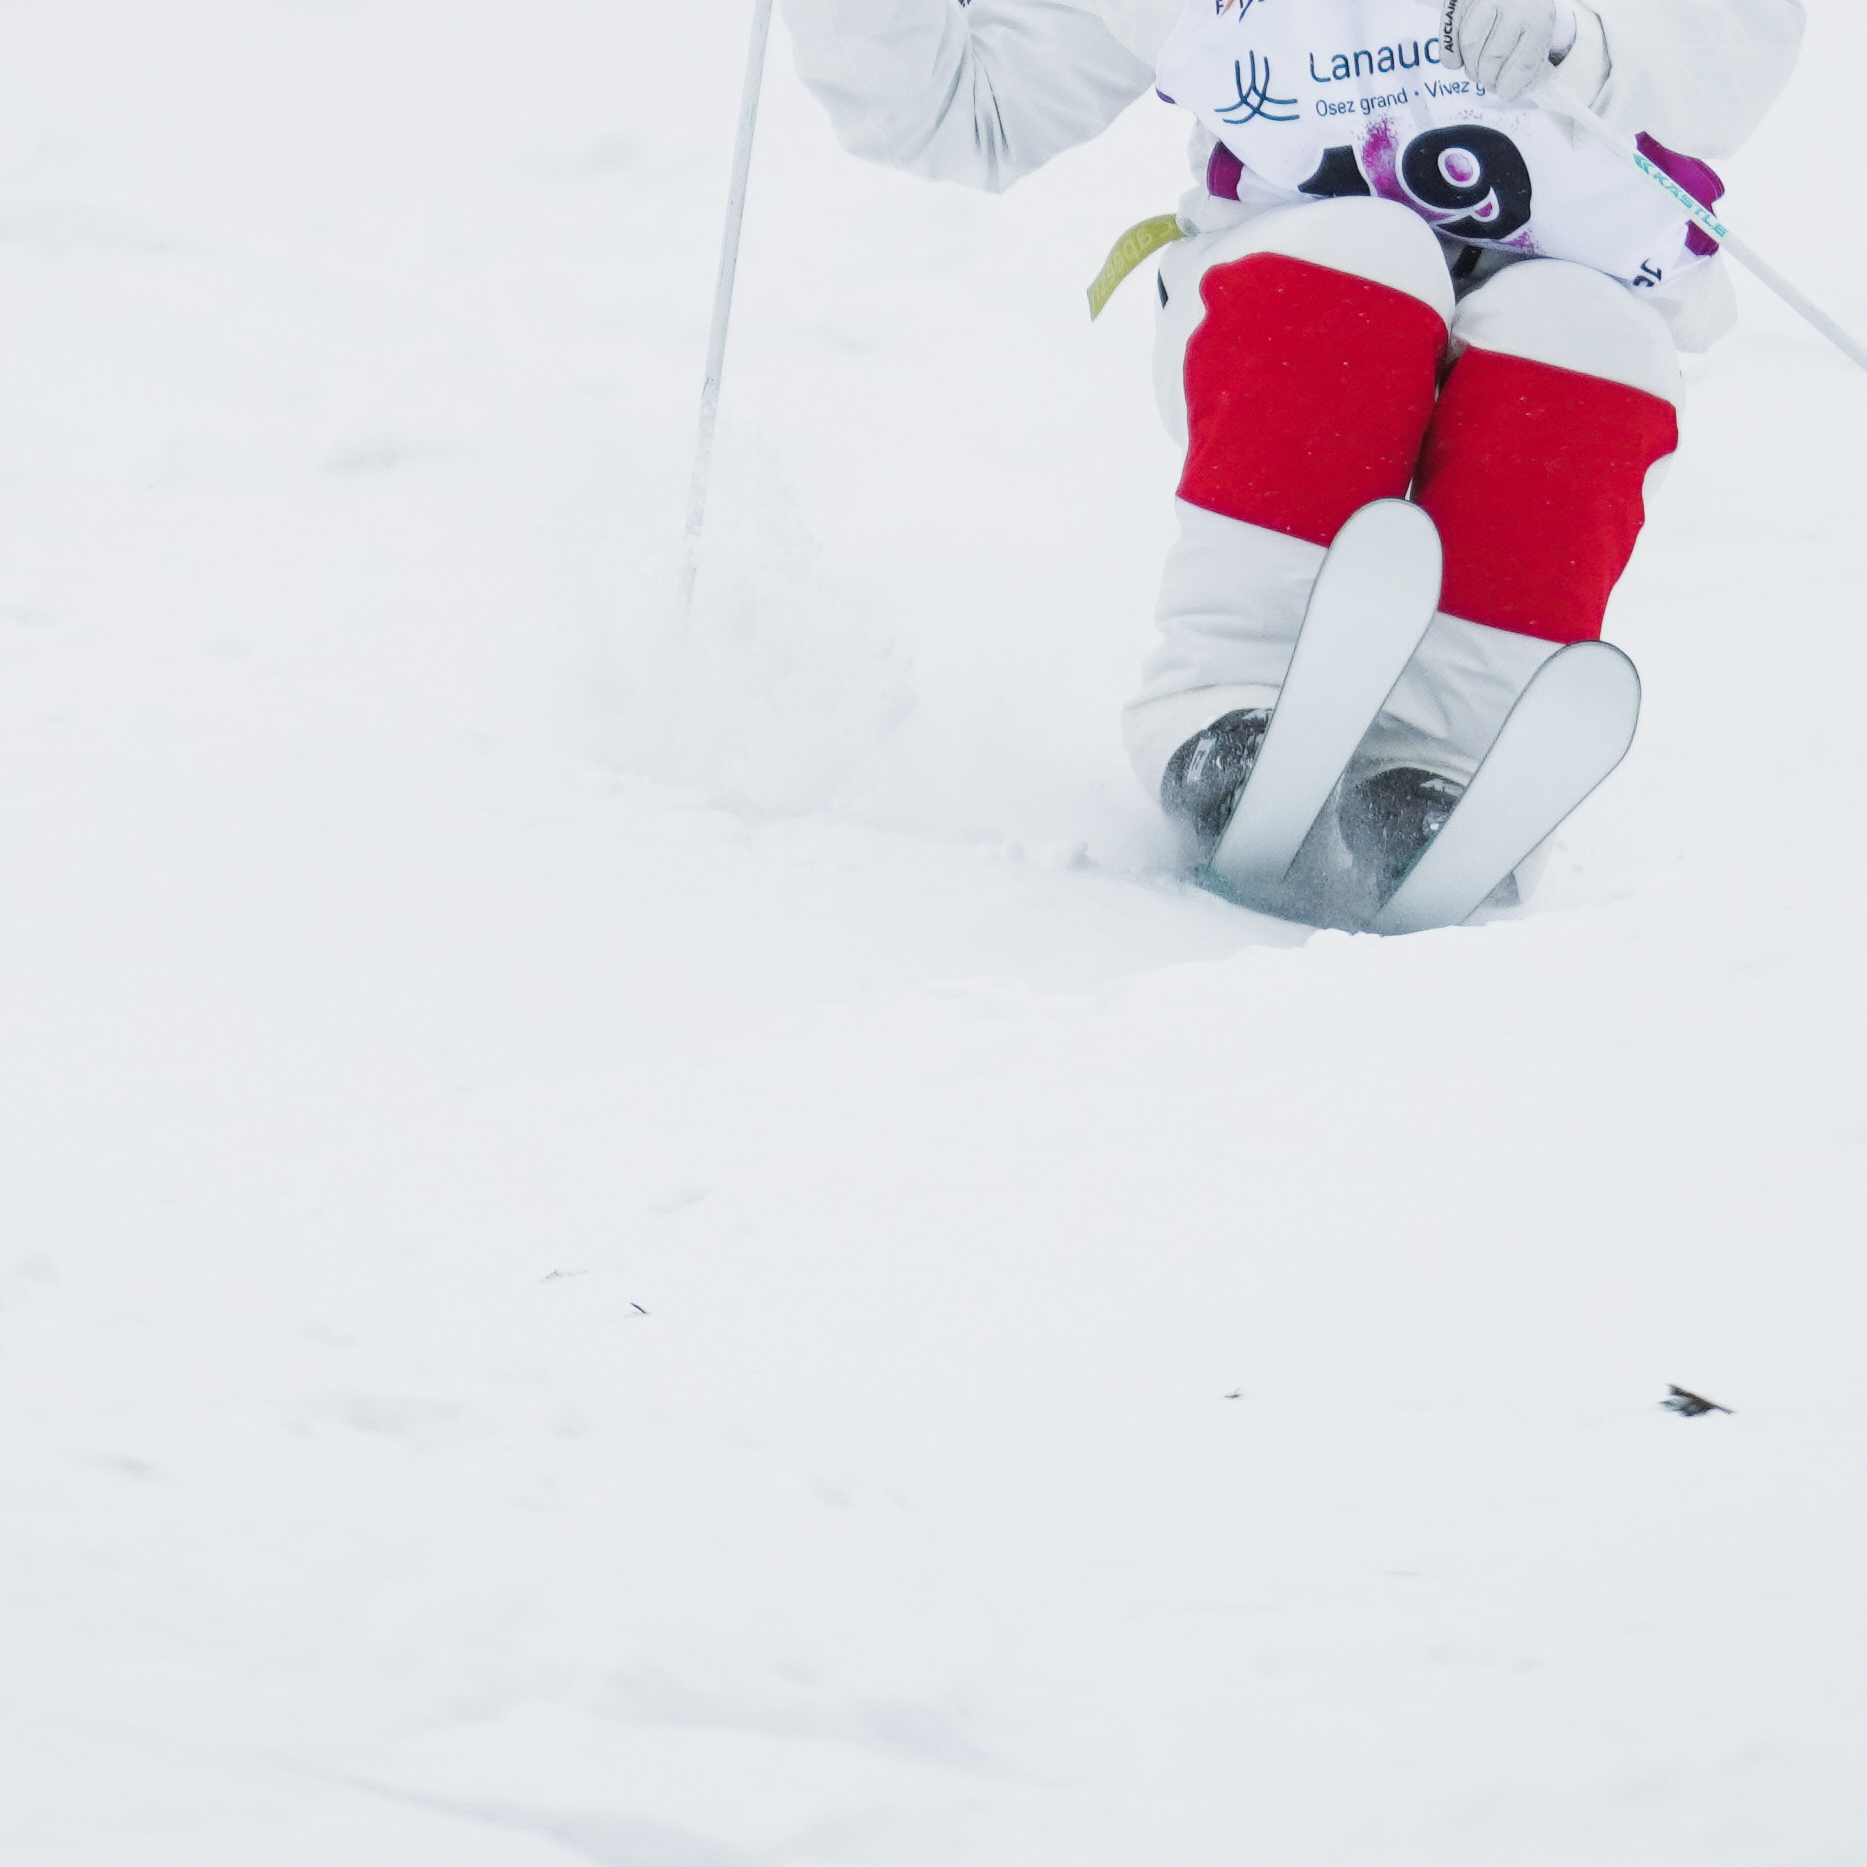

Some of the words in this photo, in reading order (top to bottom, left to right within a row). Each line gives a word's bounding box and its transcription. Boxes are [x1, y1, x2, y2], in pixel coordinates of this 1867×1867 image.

[1315, 99, 1355, 117] Osez
[1360, 87, 1408, 116] grand
[1424, 80, 1470, 98] Vivez
